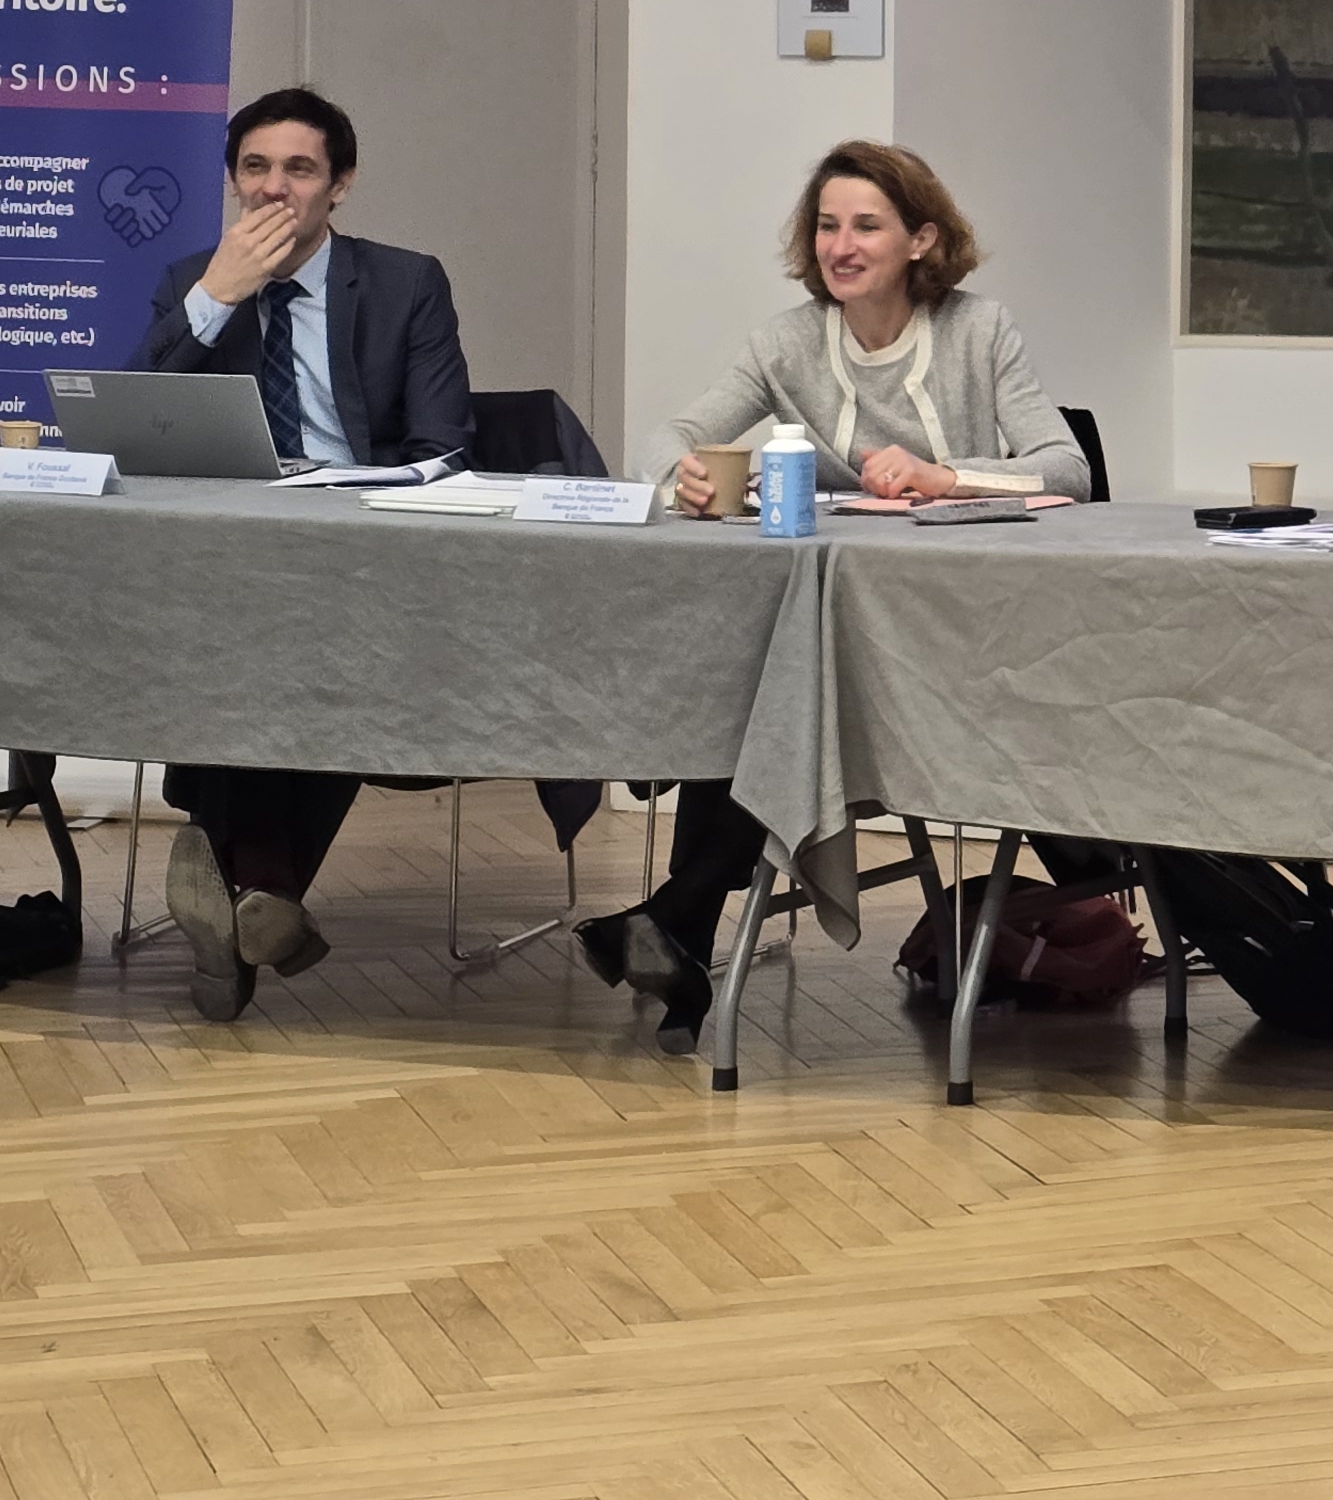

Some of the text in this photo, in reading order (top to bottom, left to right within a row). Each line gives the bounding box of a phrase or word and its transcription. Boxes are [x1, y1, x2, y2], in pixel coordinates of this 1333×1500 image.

[0, 63, 137, 95] SIONS
[5, 175, 75, 196] de projet
[1, 198, 74, 216] émarches
[9, 281, 98, 300] entreprises
